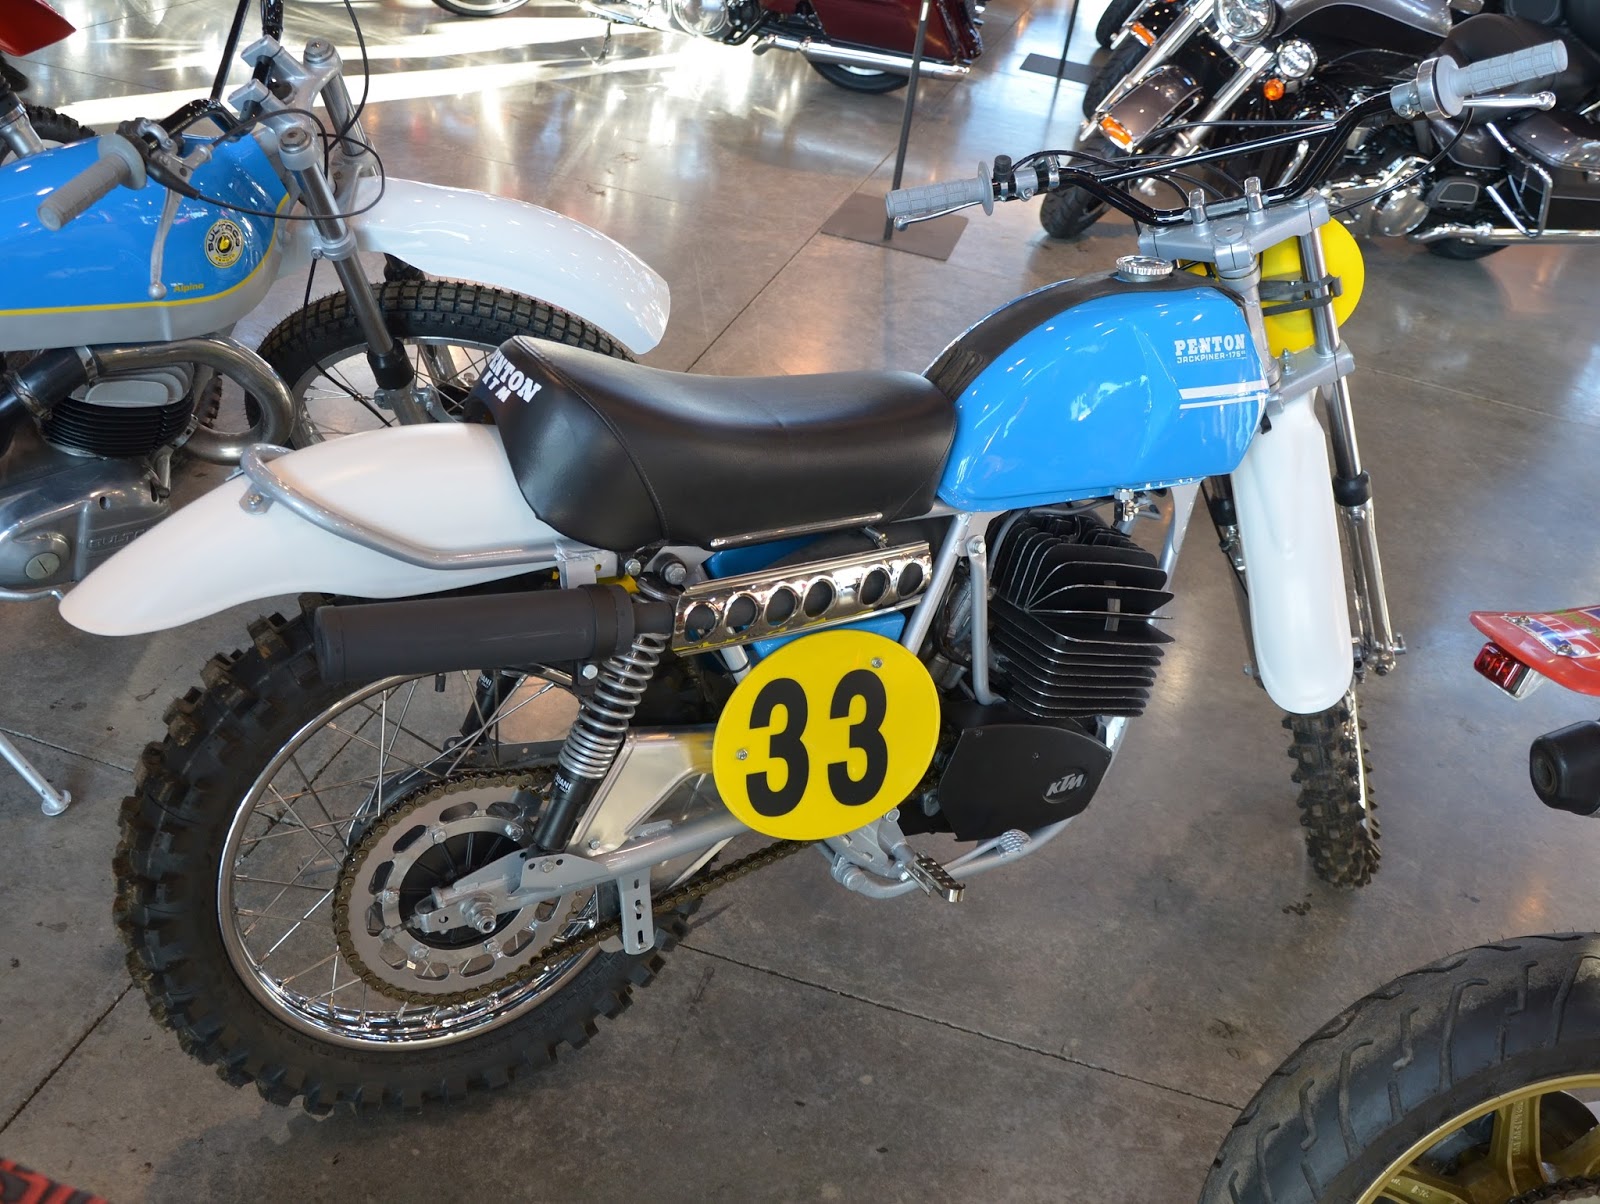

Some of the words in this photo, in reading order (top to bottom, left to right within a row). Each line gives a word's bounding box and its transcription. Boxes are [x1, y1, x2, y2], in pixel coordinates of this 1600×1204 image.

[207, 223, 240, 252] BULTACO
[1174, 333, 1246, 357] PENTON
[488, 349, 543, 403] ENTON
[745, 668, 889, 818] 33
[1046, 773, 1085, 797] KTM
